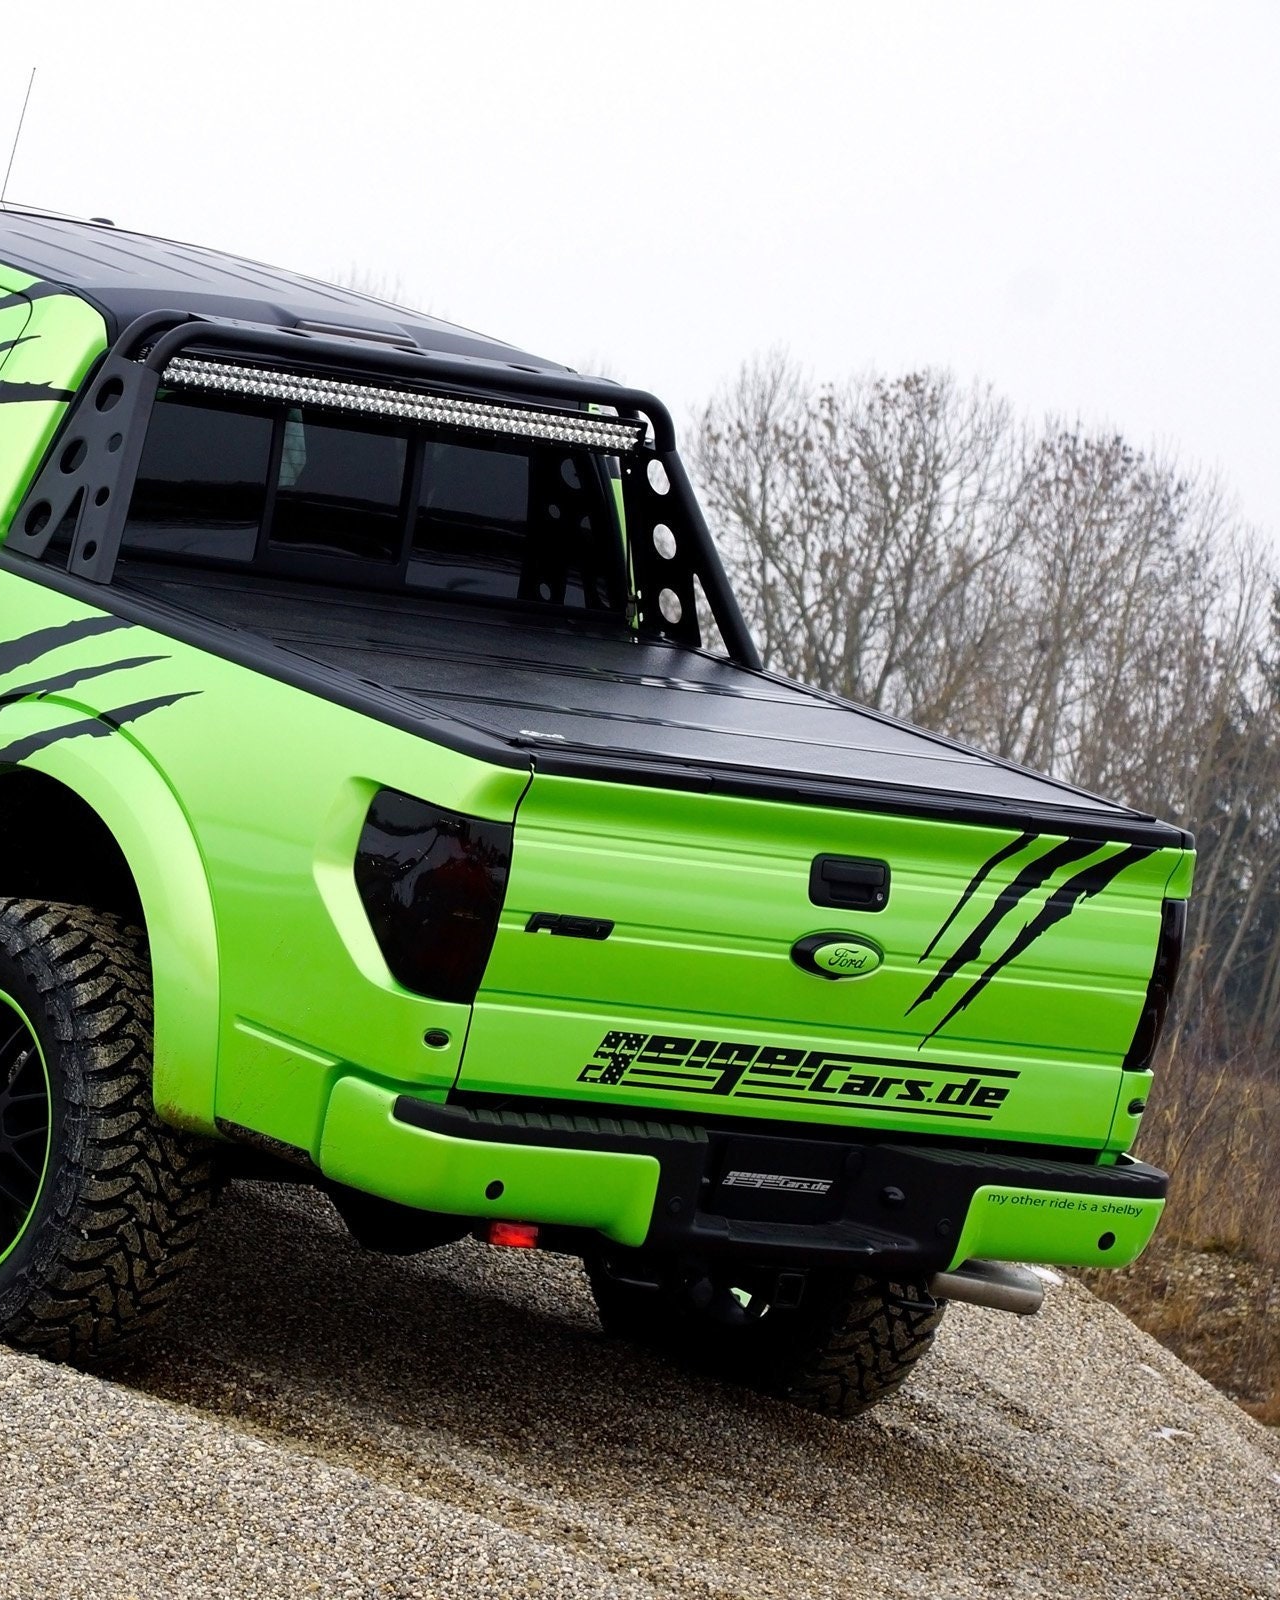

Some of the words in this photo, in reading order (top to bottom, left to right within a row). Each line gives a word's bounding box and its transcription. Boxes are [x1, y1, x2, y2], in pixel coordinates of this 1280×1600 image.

[828, 947, 868, 969] Ford
[987, 1192, 1009, 1205] my
[1011, 1194, 1047, 1207] other
[1049, 1198, 1075, 1210] ride
[1077, 1201, 1087, 1211] is
[1090, 1204, 1098, 1212] a
[1102, 1203, 1144, 1218] shelby
